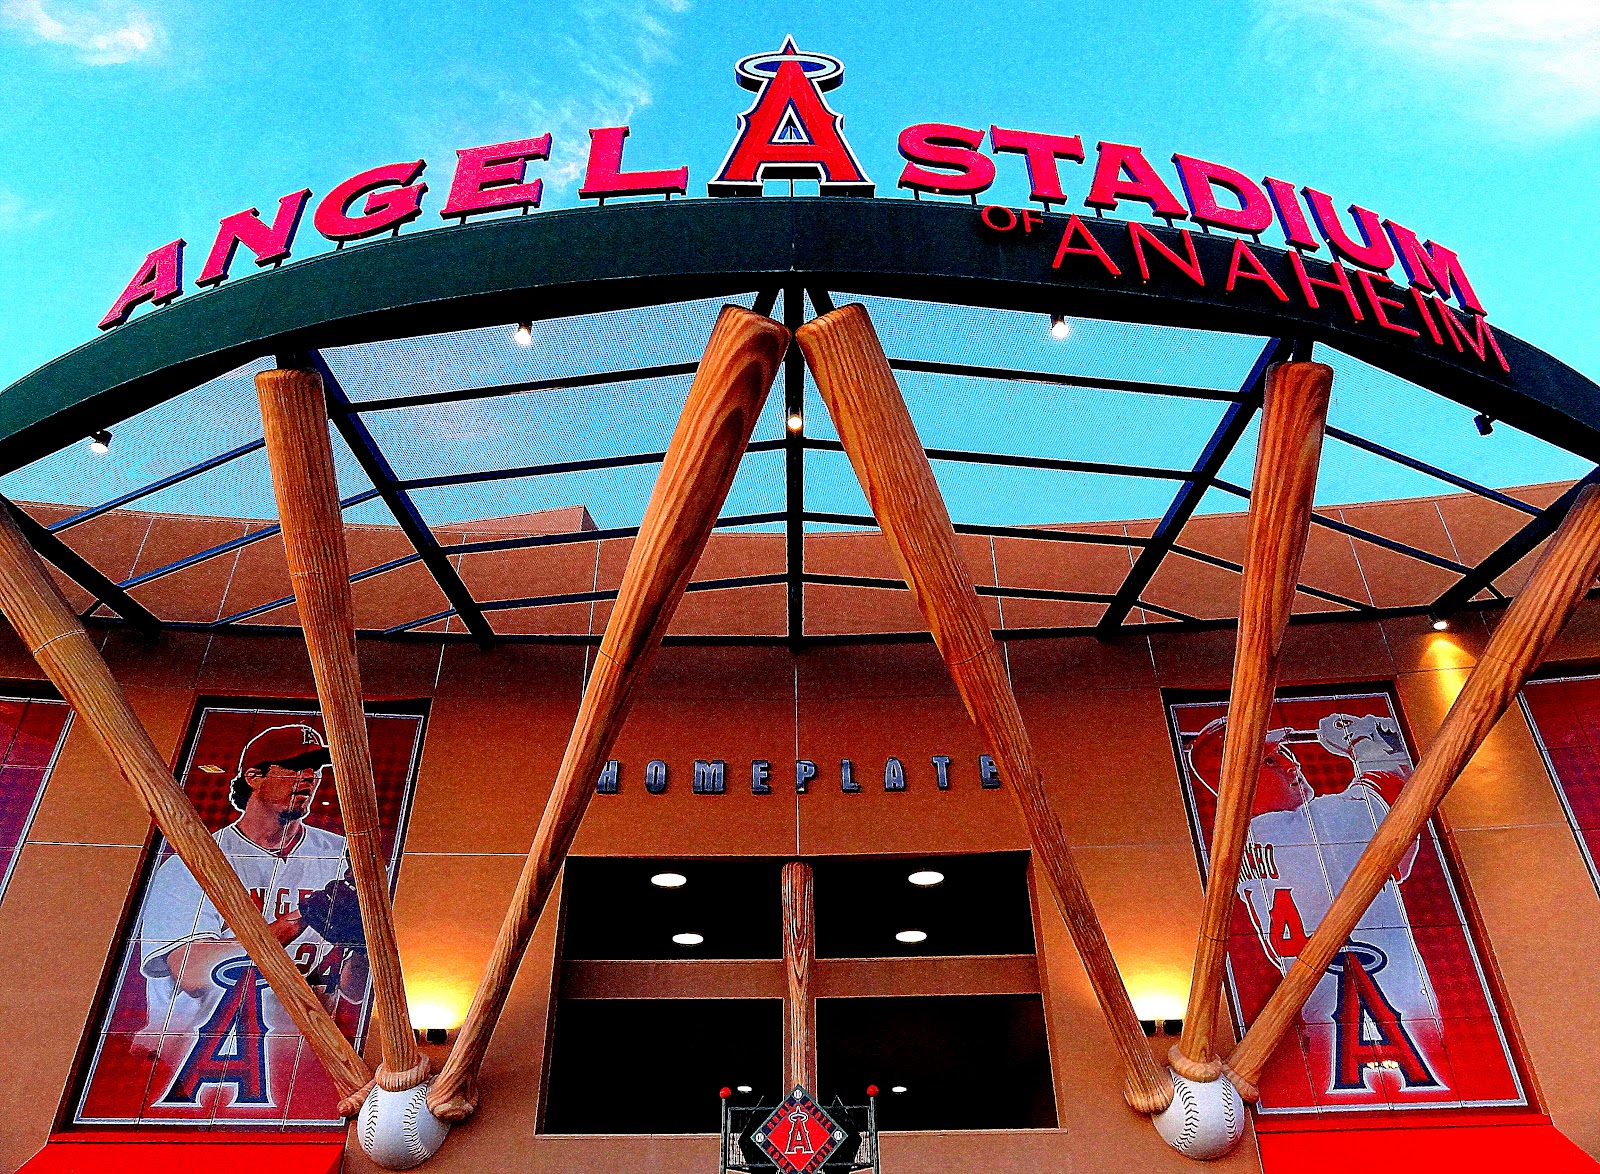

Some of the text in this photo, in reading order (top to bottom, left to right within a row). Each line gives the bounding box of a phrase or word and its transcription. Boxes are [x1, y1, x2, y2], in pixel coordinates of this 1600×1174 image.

[706, 33, 876, 197] A
[98, 122, 1488, 331] ANGEL STADIUM
[980, 204, 1510, 373] OF ANAHEIM
[784, 1105, 814, 1154] A
